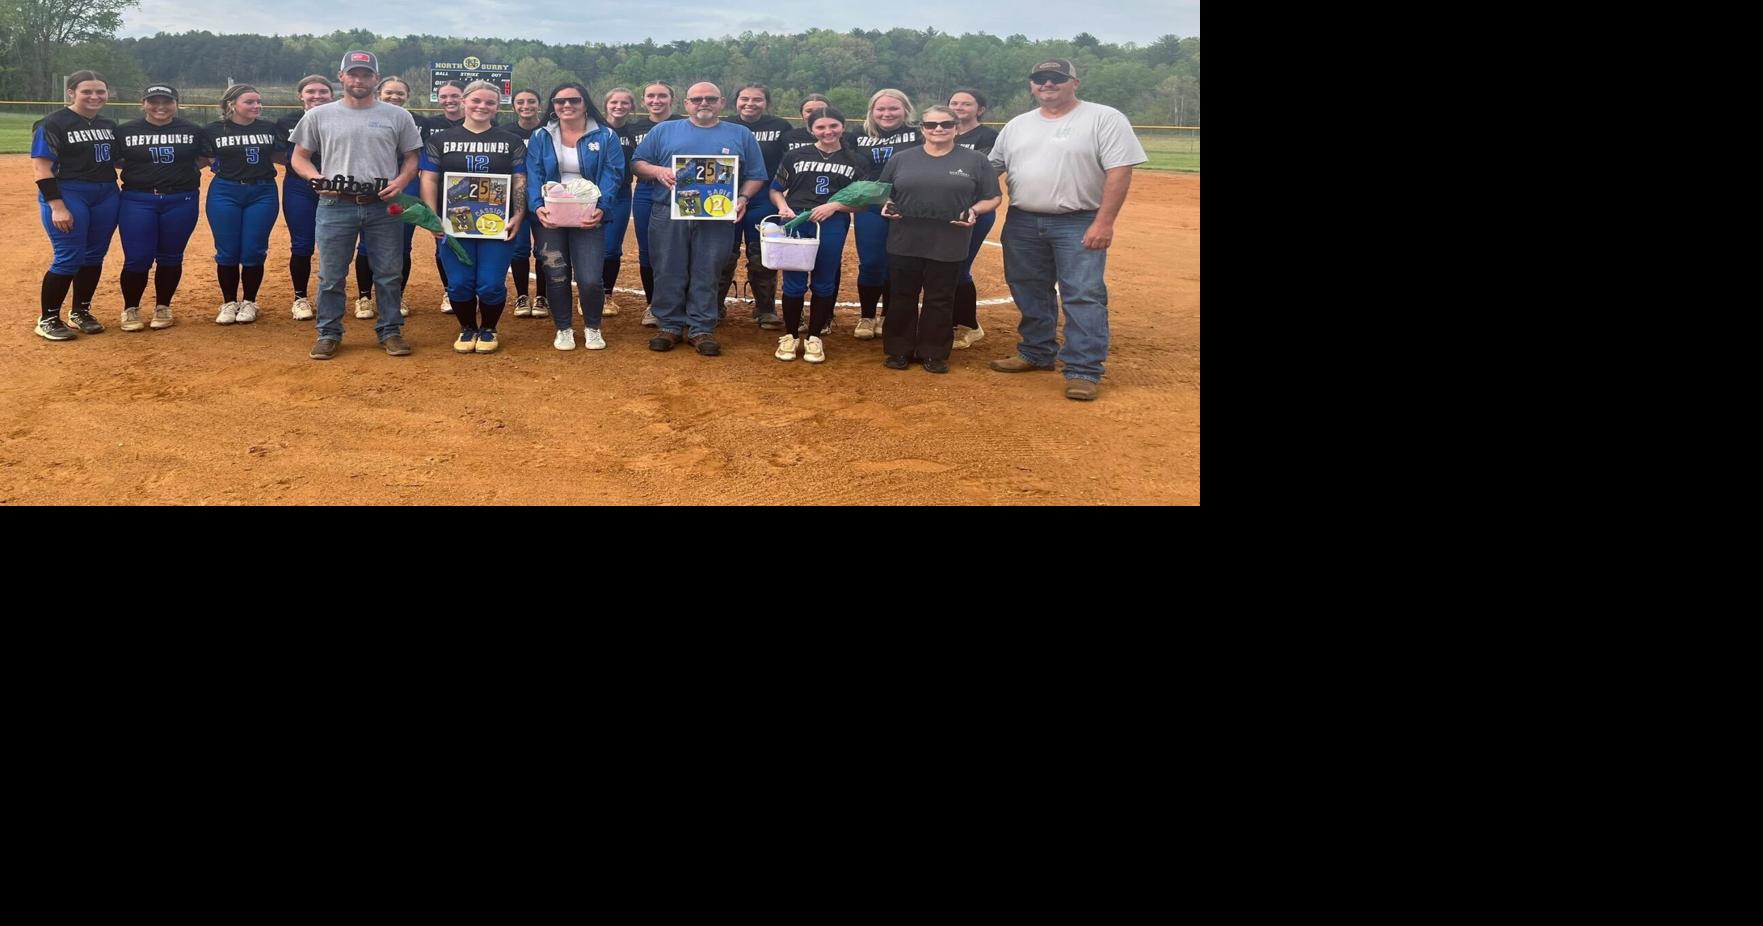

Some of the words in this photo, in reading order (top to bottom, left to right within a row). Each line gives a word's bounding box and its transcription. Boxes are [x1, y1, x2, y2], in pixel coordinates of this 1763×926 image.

[125, 134, 194, 147] GREYHOUNDS
[443, 141, 510, 154] GREYHOUNDS
[94, 143, 111, 163] 16
[149, 146, 175, 164] 15
[245, 146, 260, 165] 5
[872, 146, 894, 163] 17
[465, 154, 490, 173] 12
[815, 175, 830, 195] 2
